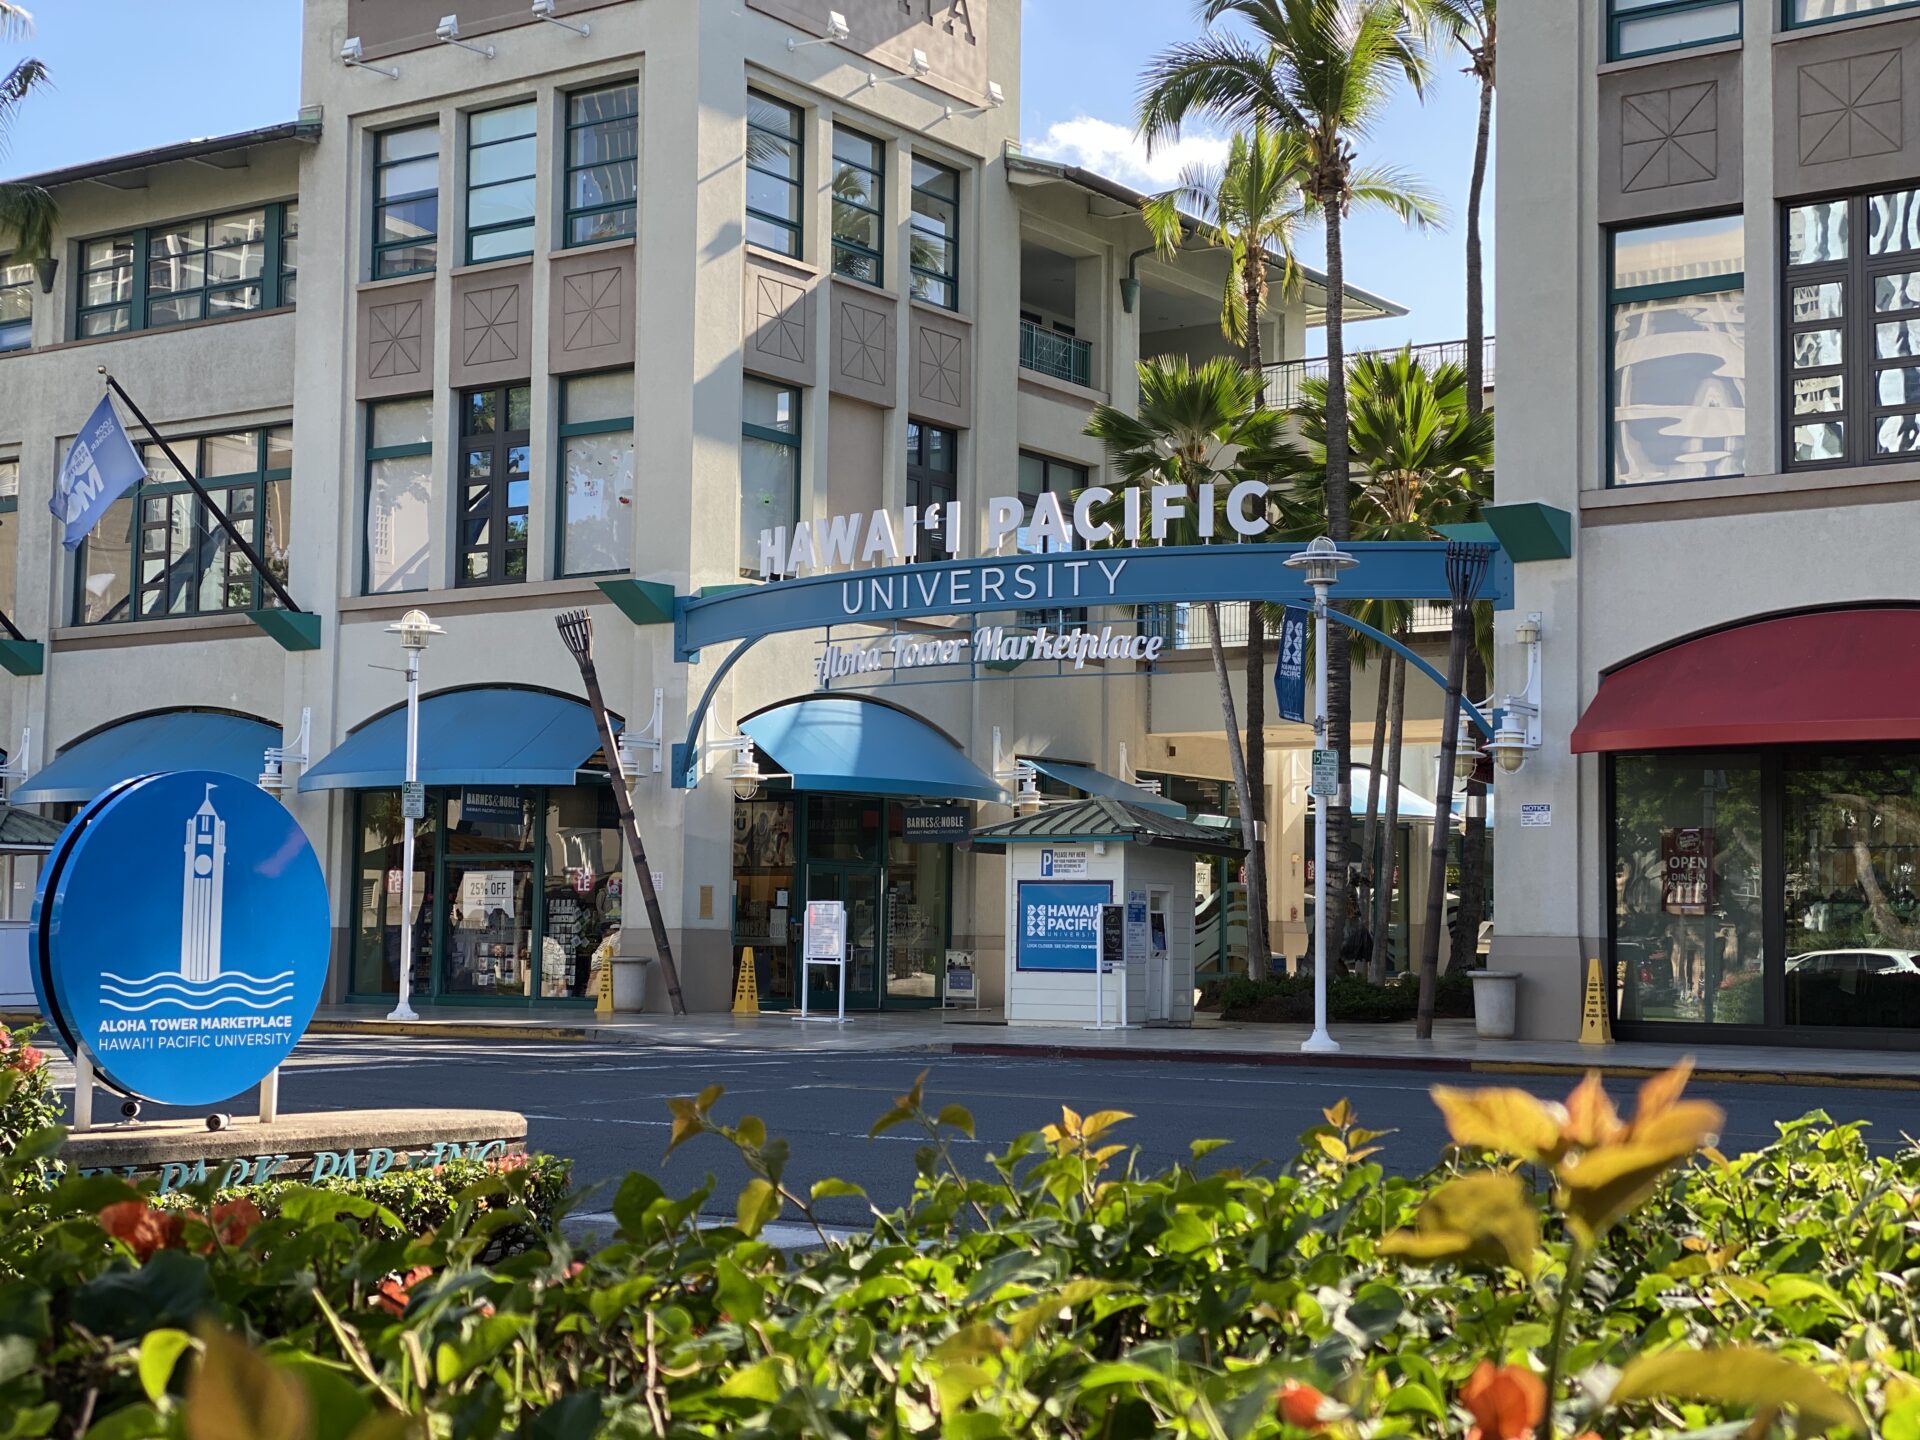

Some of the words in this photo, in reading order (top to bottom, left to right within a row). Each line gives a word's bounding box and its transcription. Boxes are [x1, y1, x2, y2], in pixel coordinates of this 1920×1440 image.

[988, 480, 1270, 548] PACIFIC
[842, 558, 1128, 614] UNIVERSITY
[816, 645, 882, 685] Aloha
[890, 633, 969, 668] Tower
[973, 626, 1164, 671] Marketplace
[1280, 670, 1301, 678] PACIFIC
[1313, 752, 1321, 764] 15
[1669, 856, 1708, 869] OPEN
[1671, 873, 1706, 882] DINE-IN
[470, 882, 489, 896] 25%
[491, 882, 507, 896] OFF
[99, 1020, 147, 1032] ALOHA
[150, 1018, 198, 1031] TOWER
[200, 1016, 292, 1029] MARKETPLACE
[158, 1035, 211, 1049] PACIFIC
[214, 1033, 292, 1047] UNIVERSITY
